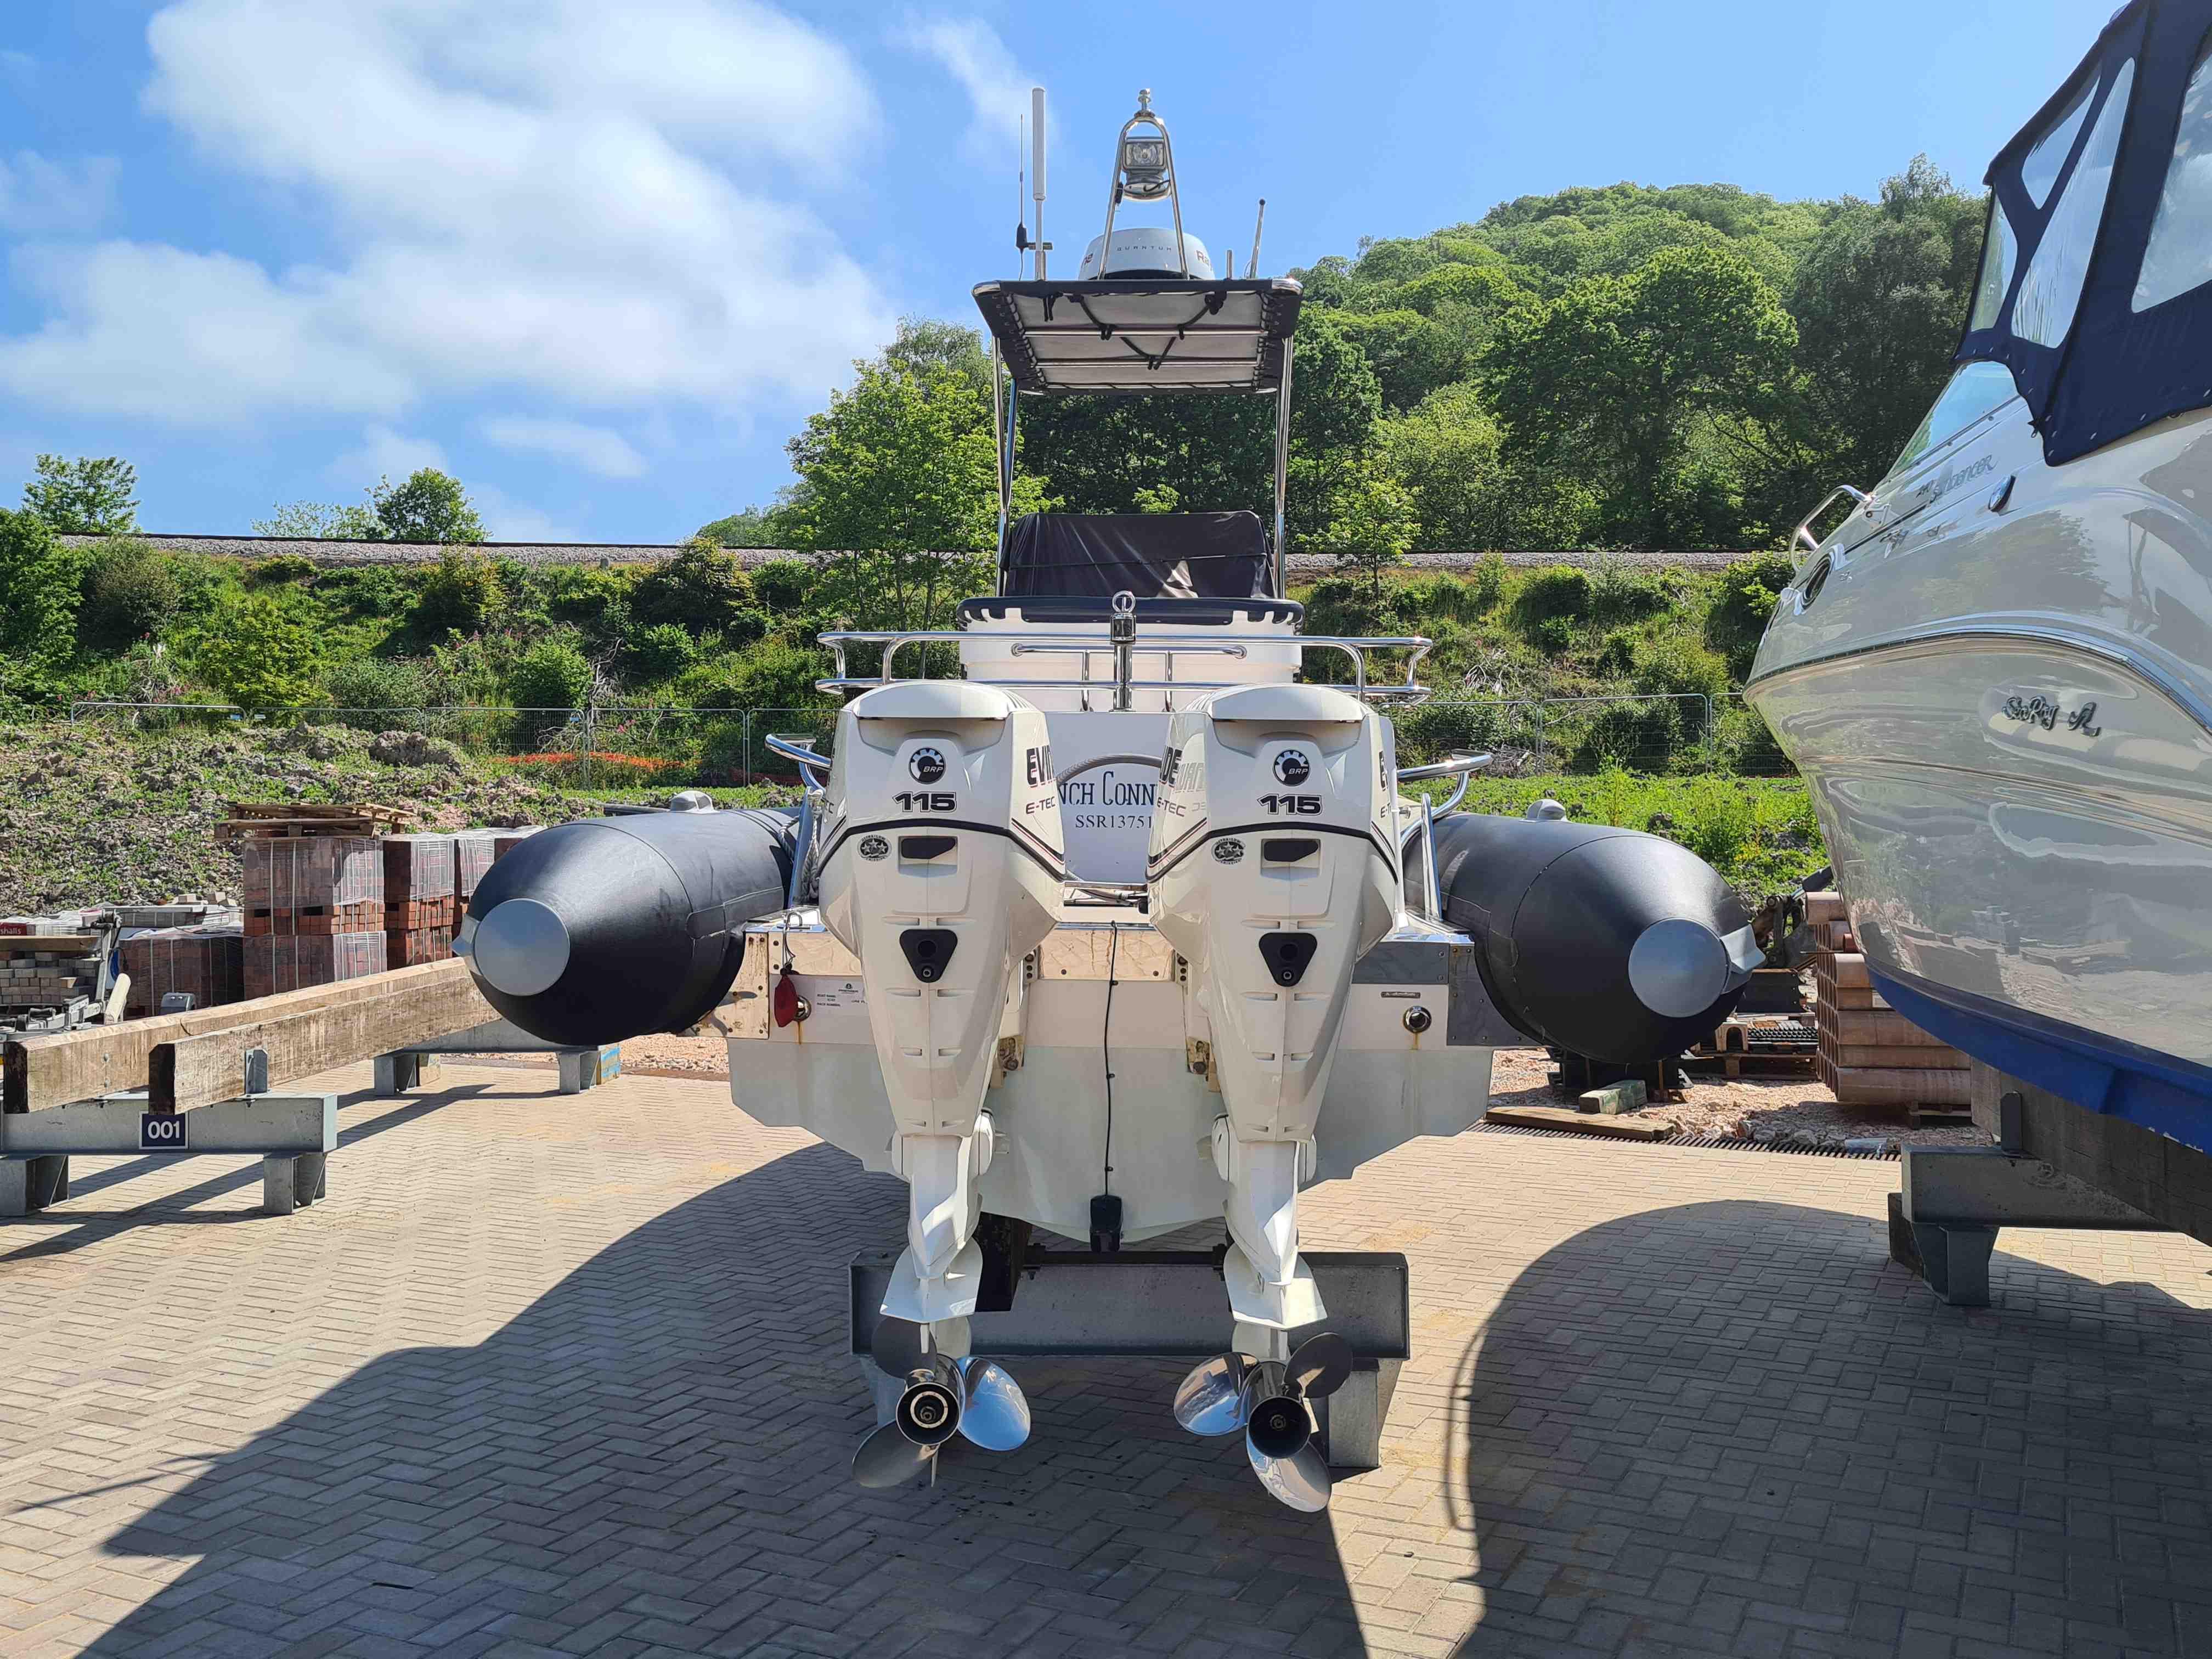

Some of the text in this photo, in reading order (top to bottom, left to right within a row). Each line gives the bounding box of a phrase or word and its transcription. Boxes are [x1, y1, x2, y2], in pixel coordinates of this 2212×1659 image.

[894, 791, 957, 812] 115
[1025, 796, 1056, 815] E-TEC
[1156, 797, 1187, 817] E-TEC
[1257, 794, 1323, 816] 115
[148, 1120, 179, 1139] 001
